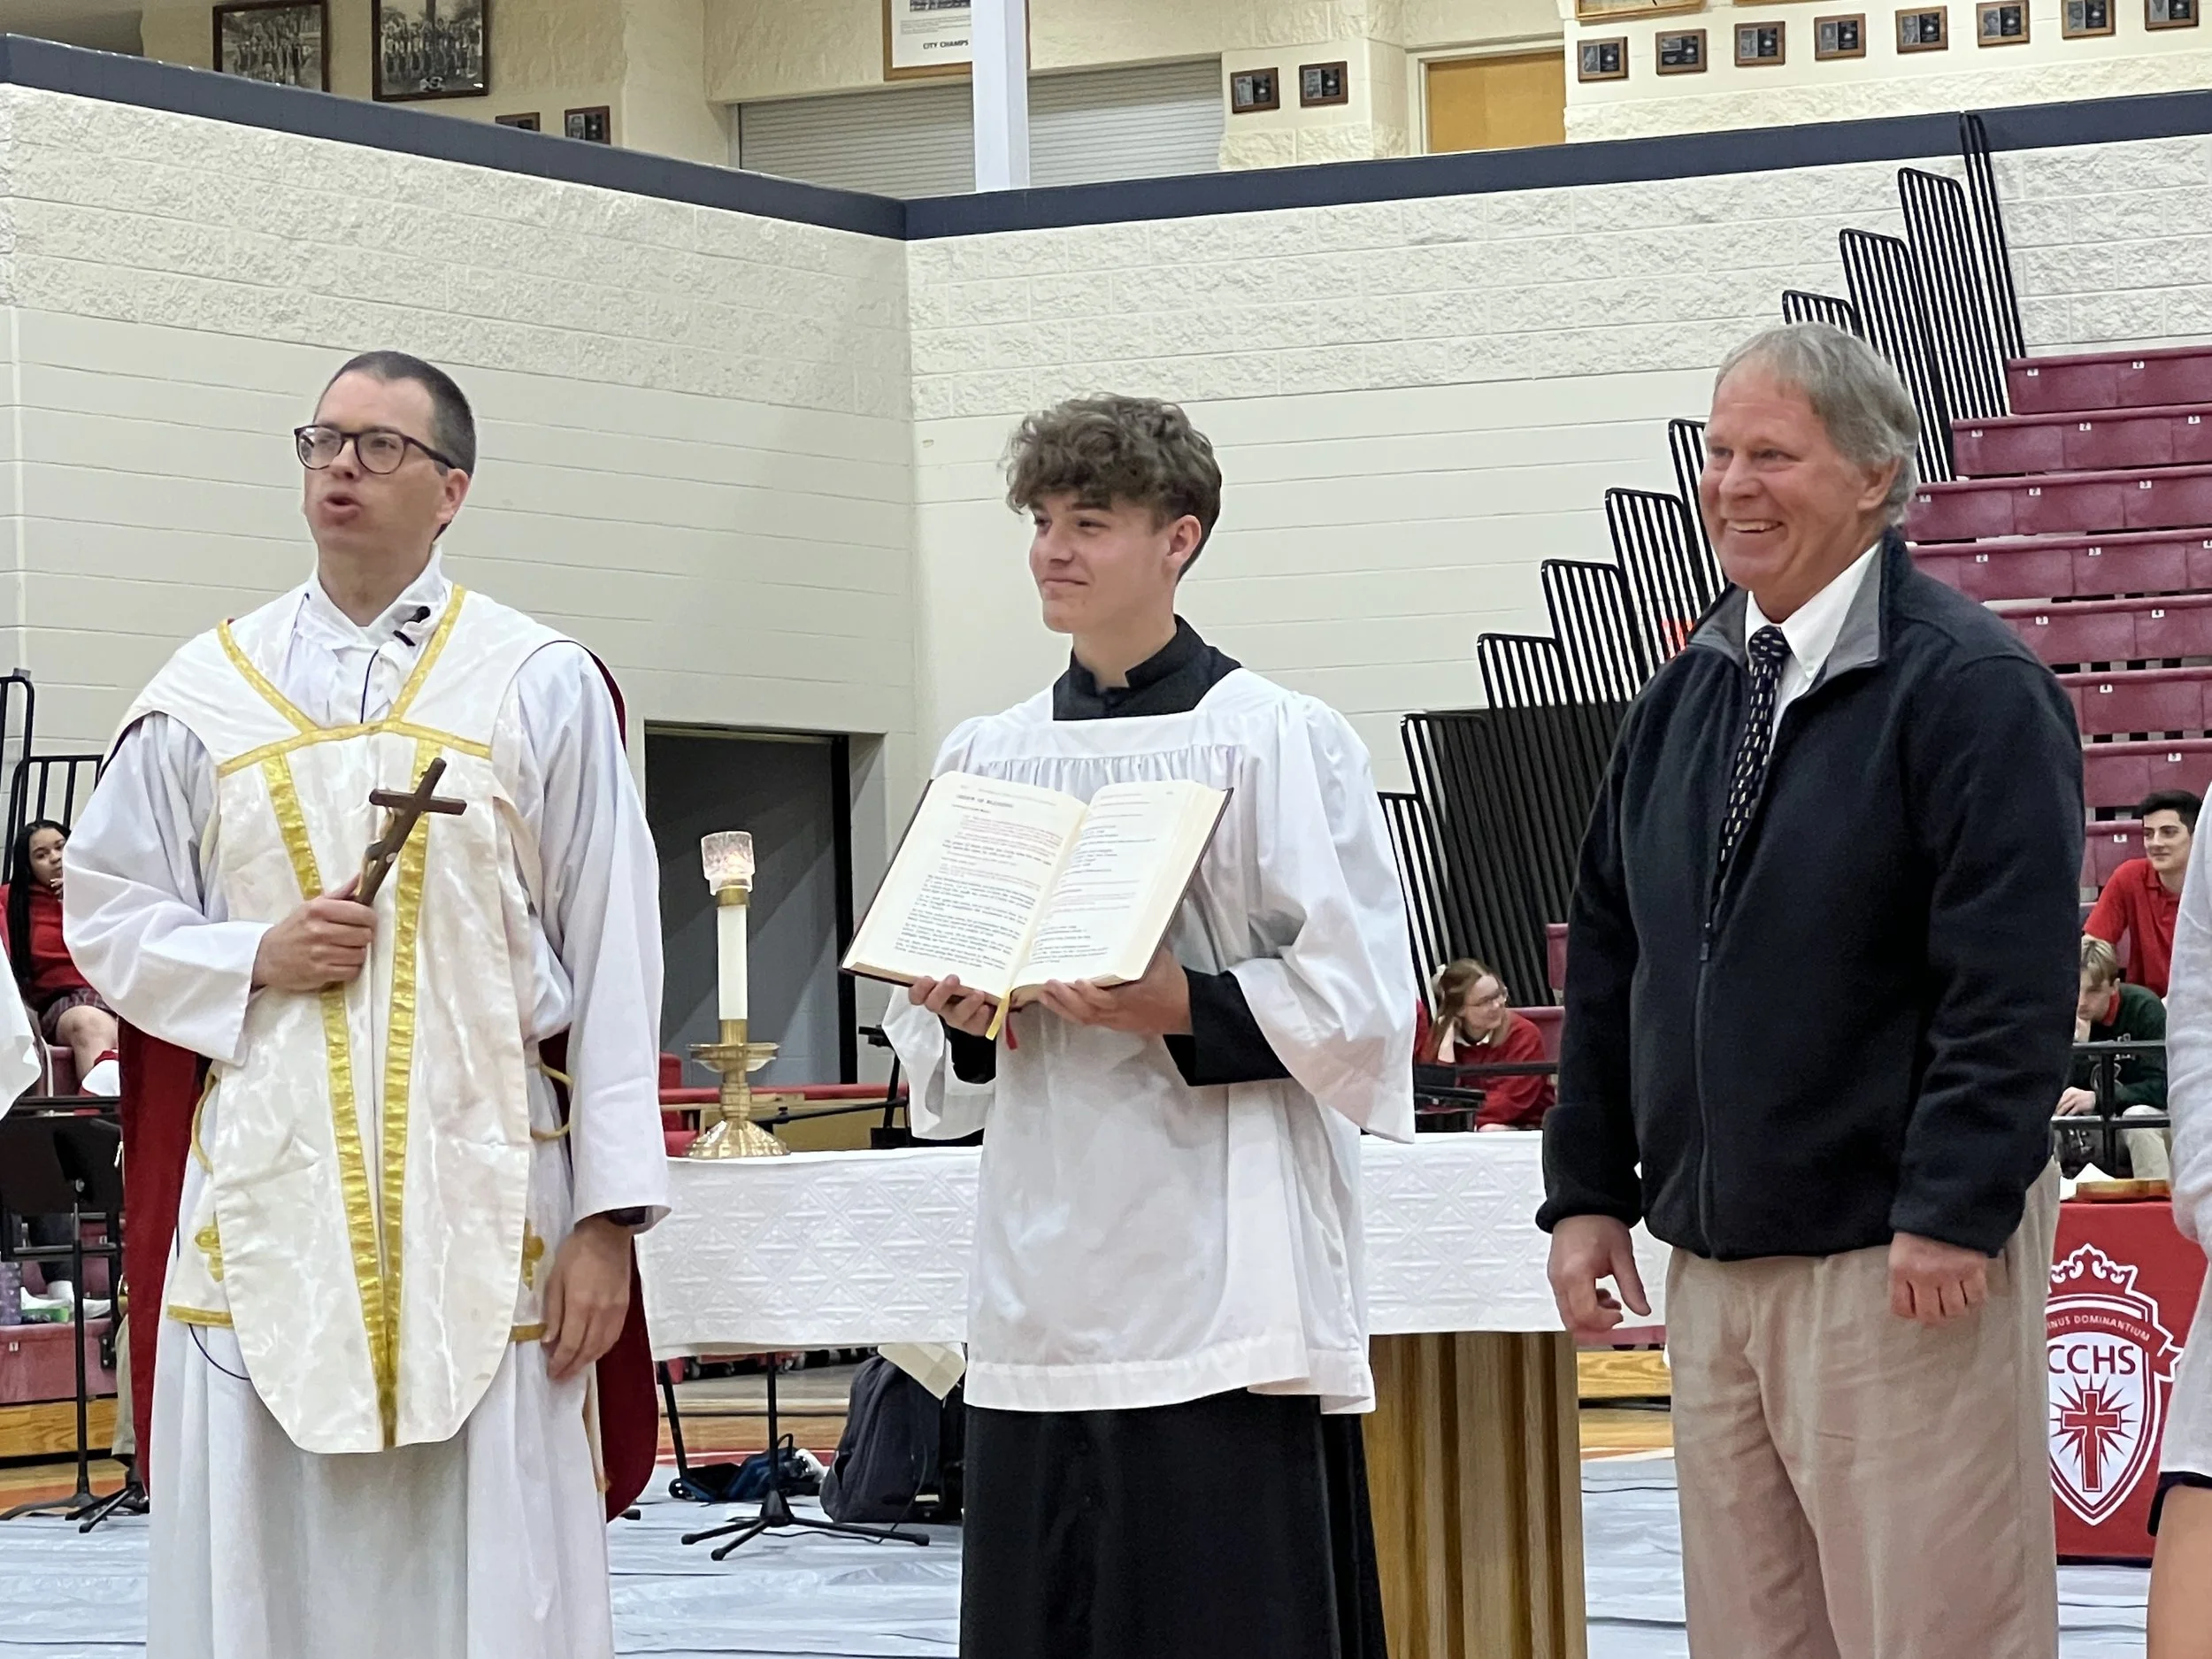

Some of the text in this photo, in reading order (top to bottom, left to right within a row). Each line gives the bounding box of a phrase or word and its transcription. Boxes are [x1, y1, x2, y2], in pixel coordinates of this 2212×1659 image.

[940, 39, 969, 48] CHAMPS
[2074, 1315, 2150, 1341] DOMINANTIUM
[2048, 1344, 2136, 1375] CCHS
